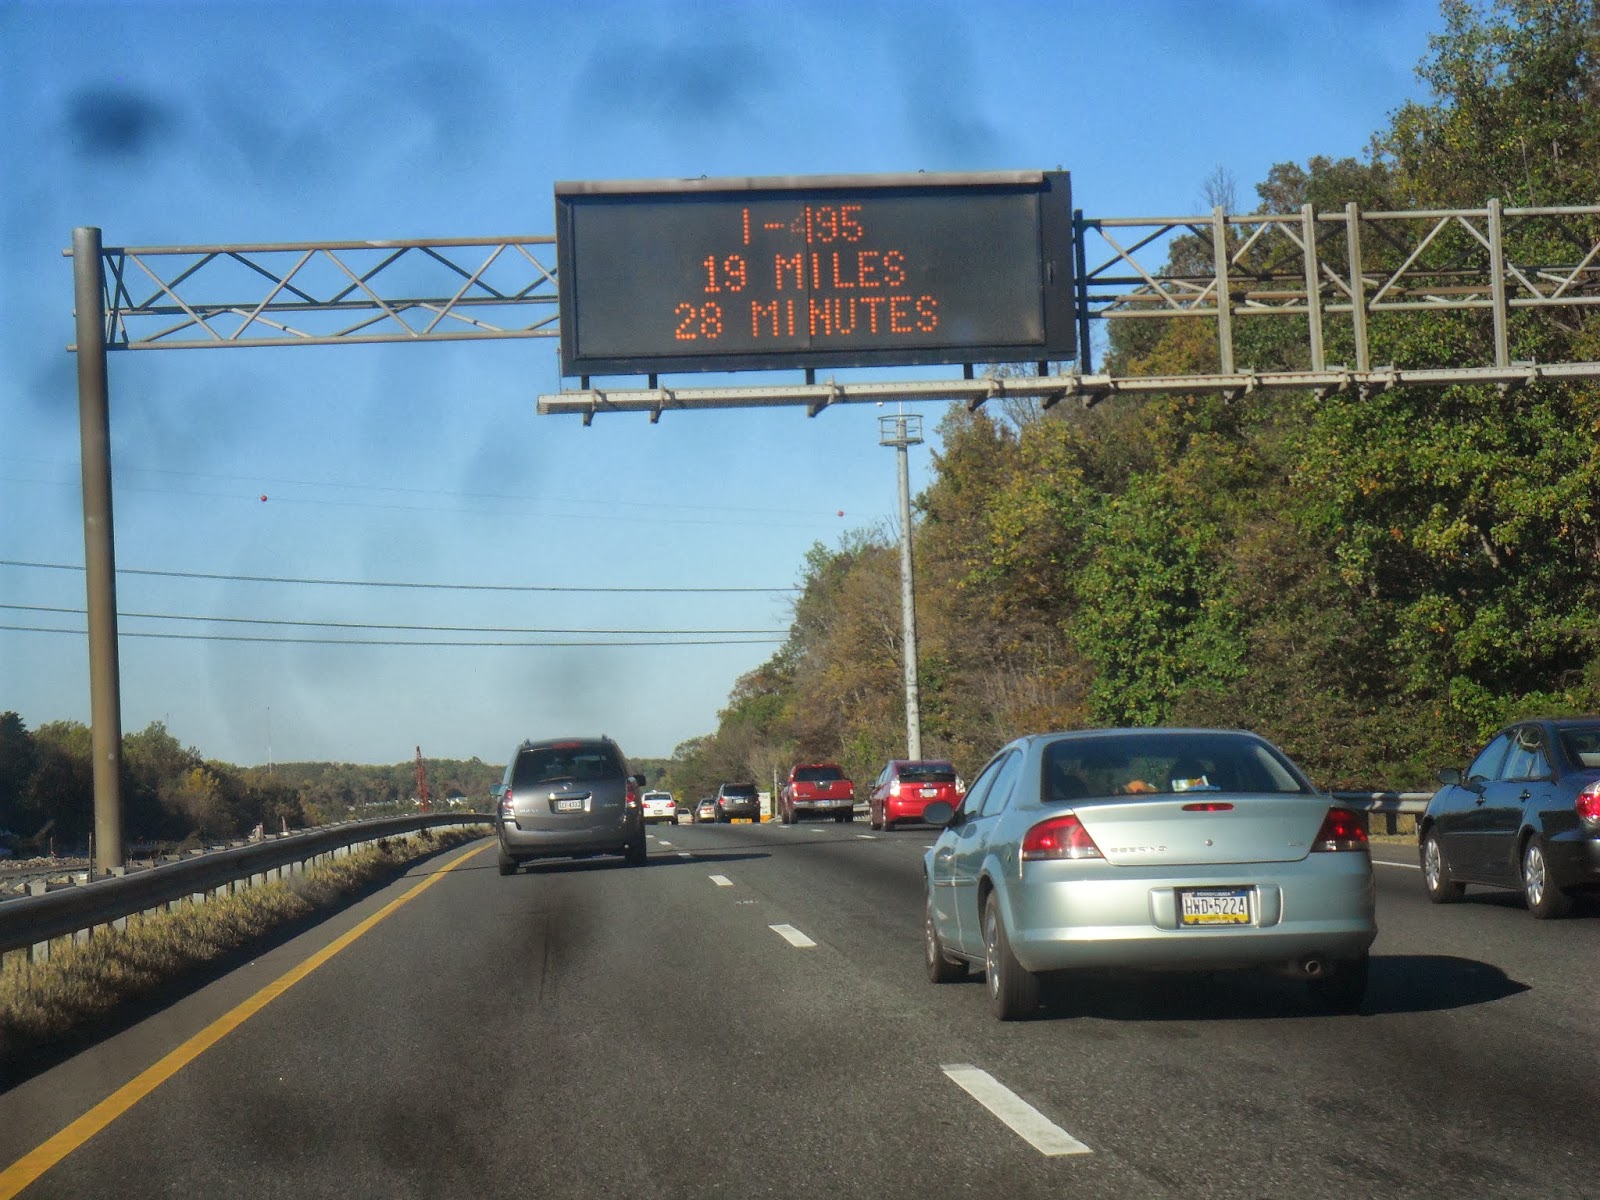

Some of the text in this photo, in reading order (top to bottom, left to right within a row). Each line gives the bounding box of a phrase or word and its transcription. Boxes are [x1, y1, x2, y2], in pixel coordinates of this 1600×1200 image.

[703, 250, 907, 294] 19 MILES
[674, 295, 939, 341] 28 MINUTES
